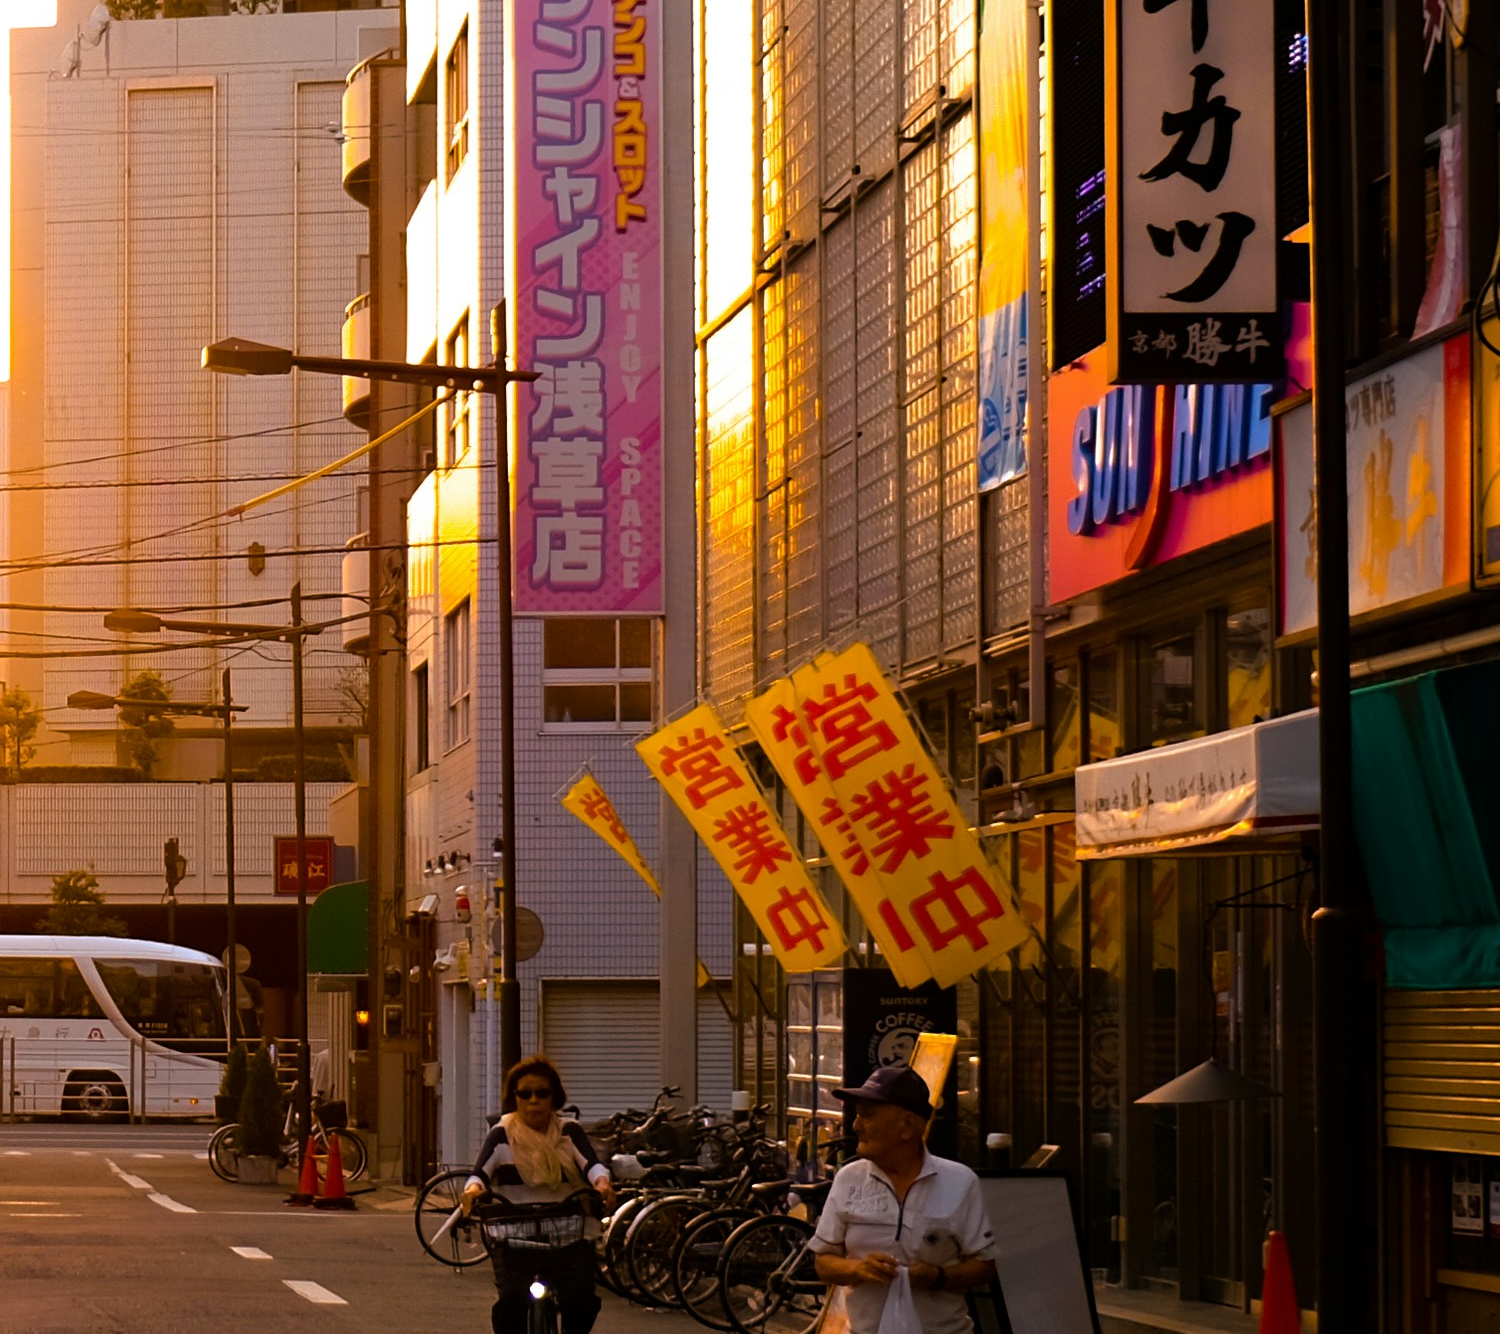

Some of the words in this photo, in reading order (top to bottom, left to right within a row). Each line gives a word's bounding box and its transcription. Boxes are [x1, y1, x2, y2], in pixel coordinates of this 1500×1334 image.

[621, 252, 641, 405] ENJOY
[1346, 373, 1397, 437] ツ専門店
[621, 436, 641, 590] SPACE
[660, 726, 832, 955] 営業中
[804, 673, 1005, 953] 営業中
[875, 1011, 936, 1034] COFFEE
[880, 997, 929, 1006] SUNTORY
